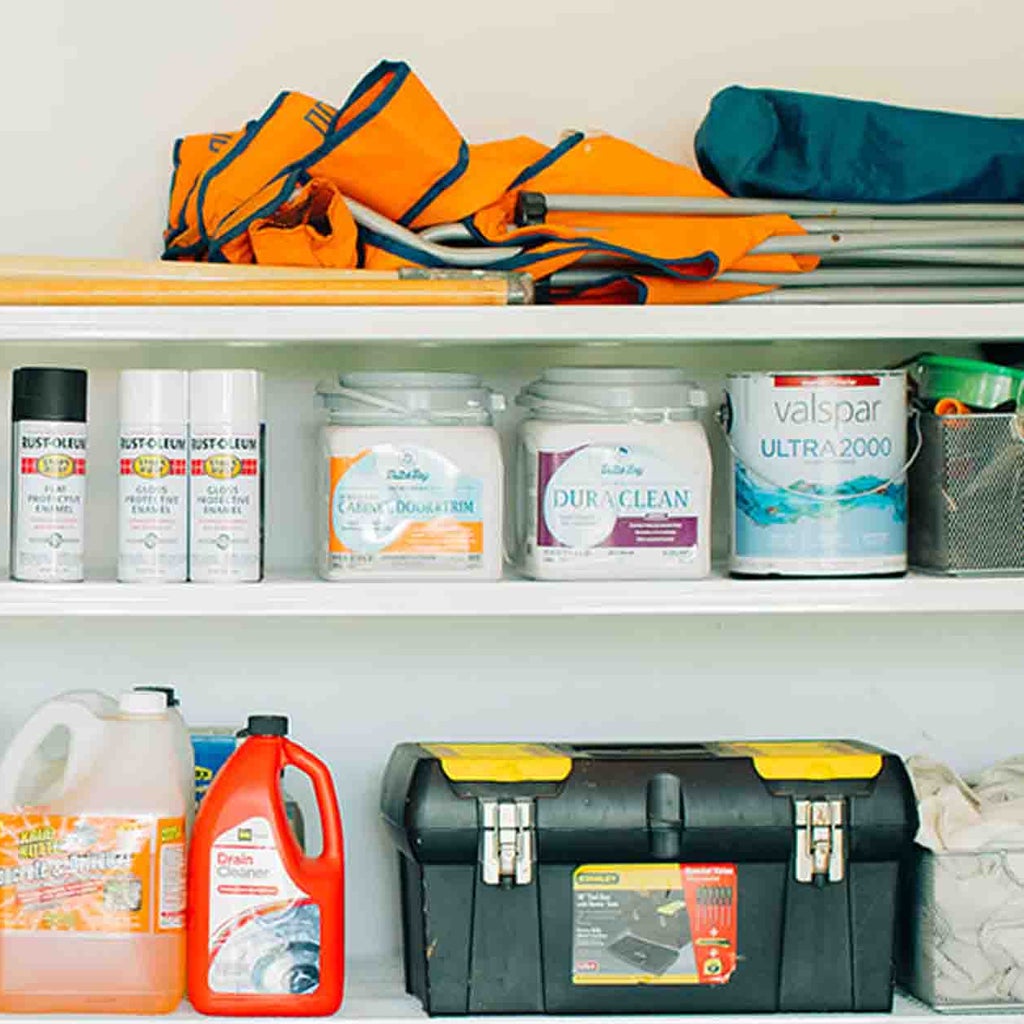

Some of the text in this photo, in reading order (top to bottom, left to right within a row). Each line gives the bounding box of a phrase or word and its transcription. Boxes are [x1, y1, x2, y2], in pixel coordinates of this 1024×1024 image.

[775, 392, 882, 429] valspar
[217, 852, 254, 864] Drain
[217, 866, 270, 878] Cleaner
